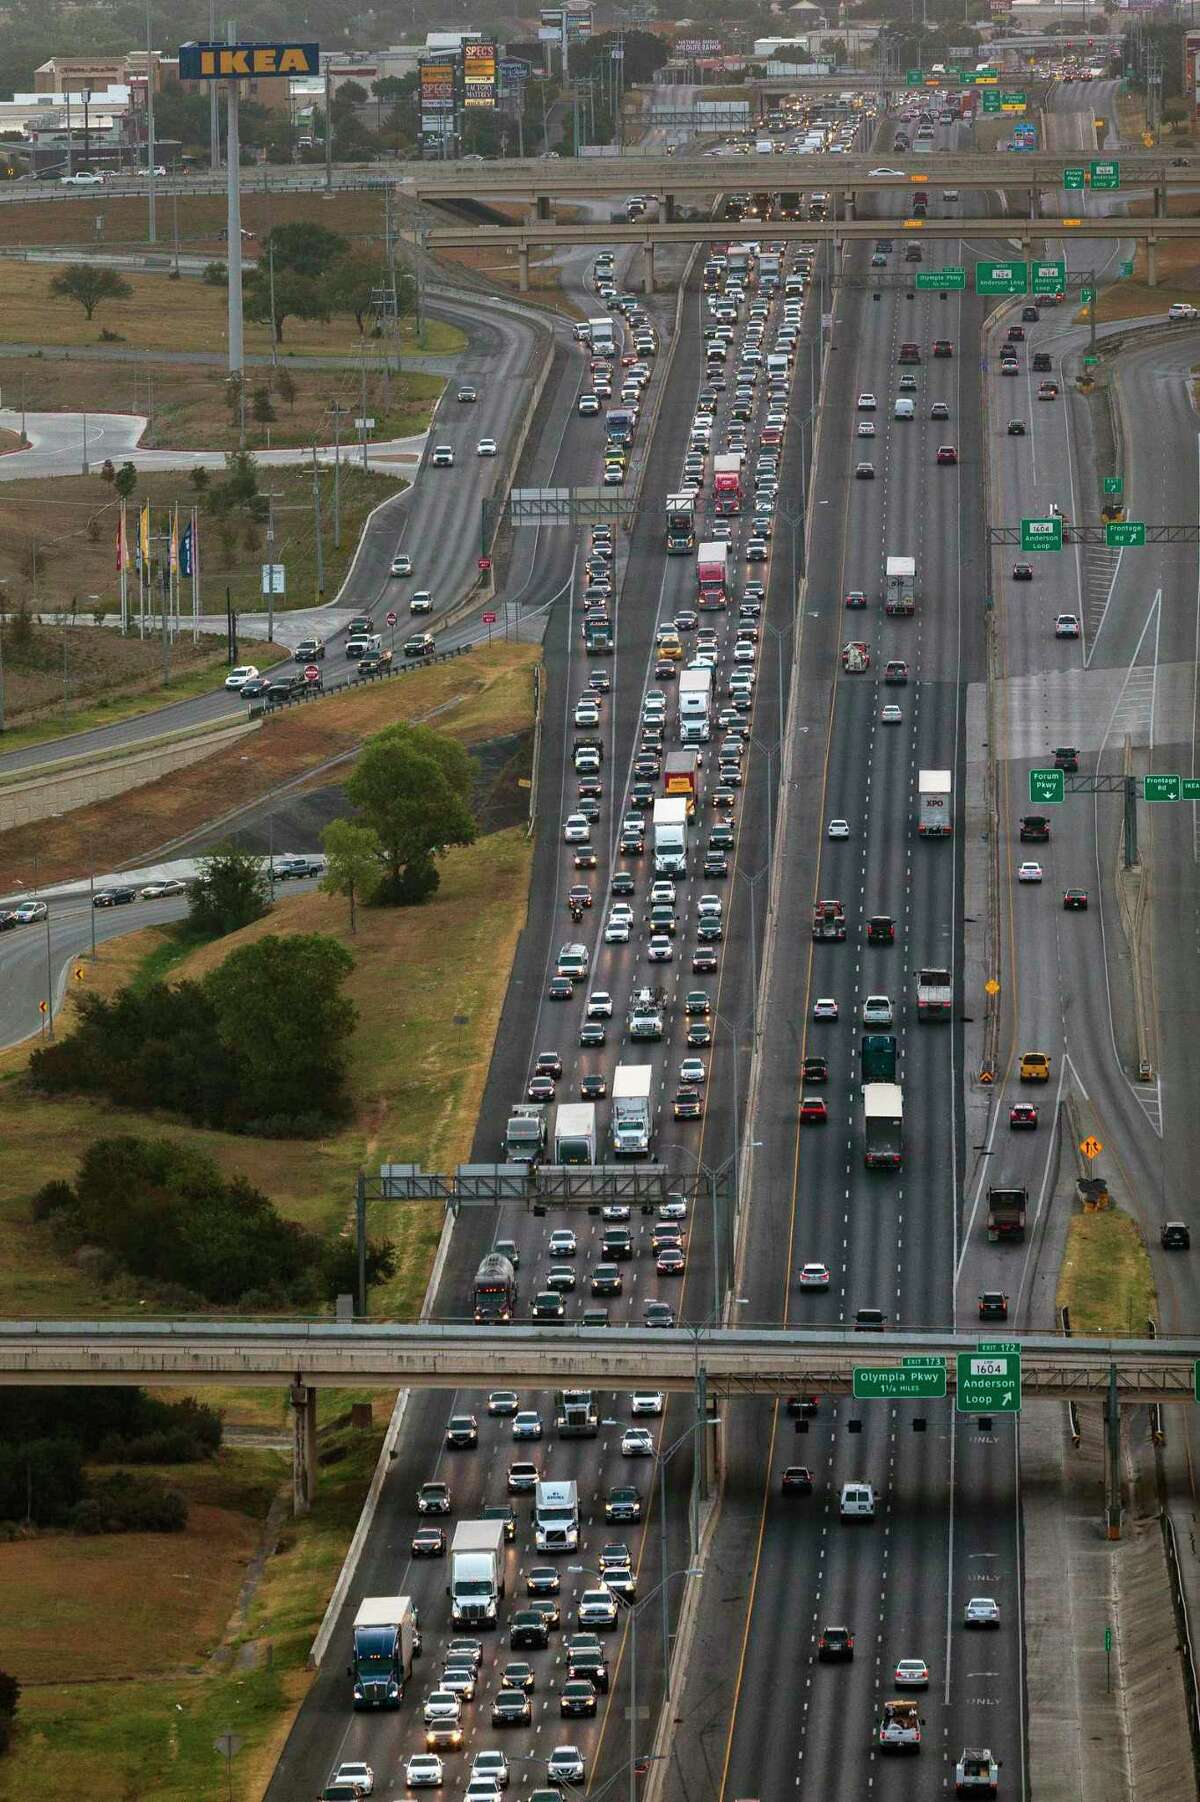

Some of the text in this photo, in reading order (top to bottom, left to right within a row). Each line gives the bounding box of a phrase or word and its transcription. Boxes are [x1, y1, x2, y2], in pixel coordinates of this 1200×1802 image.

[201, 48, 310, 75] IKEA
[1036, 781, 1057, 790] Pkwy
[1147, 777, 1177, 785] Frontage
[1000, 1344, 1016, 1352] 172
[976, 1364, 1001, 1374] 1604
[860, 1372, 939, 1383] Olympia Pkwy
[963, 1379, 1015, 1388] Anderson
[966, 1394, 992, 1405] Loop
[966, 1697, 1001, 1705] ONLY
